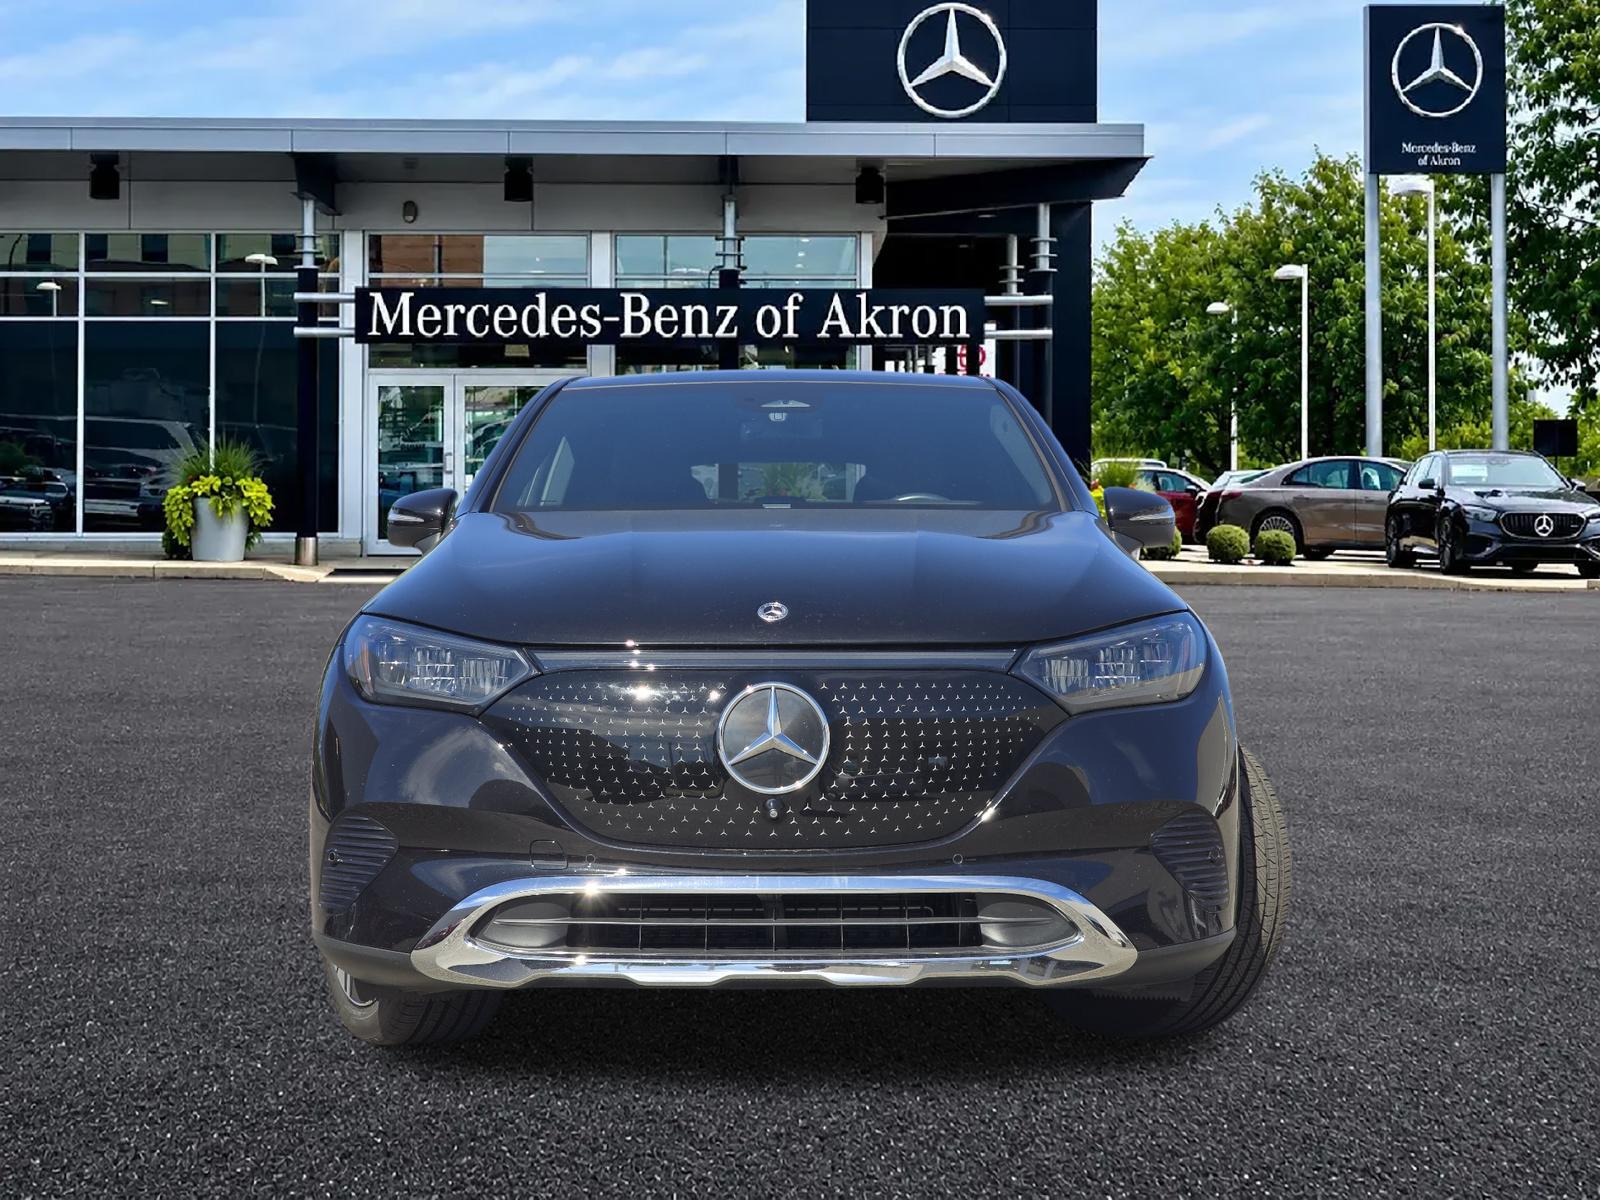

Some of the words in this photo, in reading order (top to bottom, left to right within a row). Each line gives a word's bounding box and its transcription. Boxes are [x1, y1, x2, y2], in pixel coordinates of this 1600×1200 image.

[1401, 142, 1477, 154] Mercedes-Benz
[1417, 155, 1428, 166] of
[1429, 155, 1461, 166] Akron
[367, 291, 738, 338] Mercedes-Benz
[755, 292, 804, 338] of
[816, 291, 971, 338] Akron
